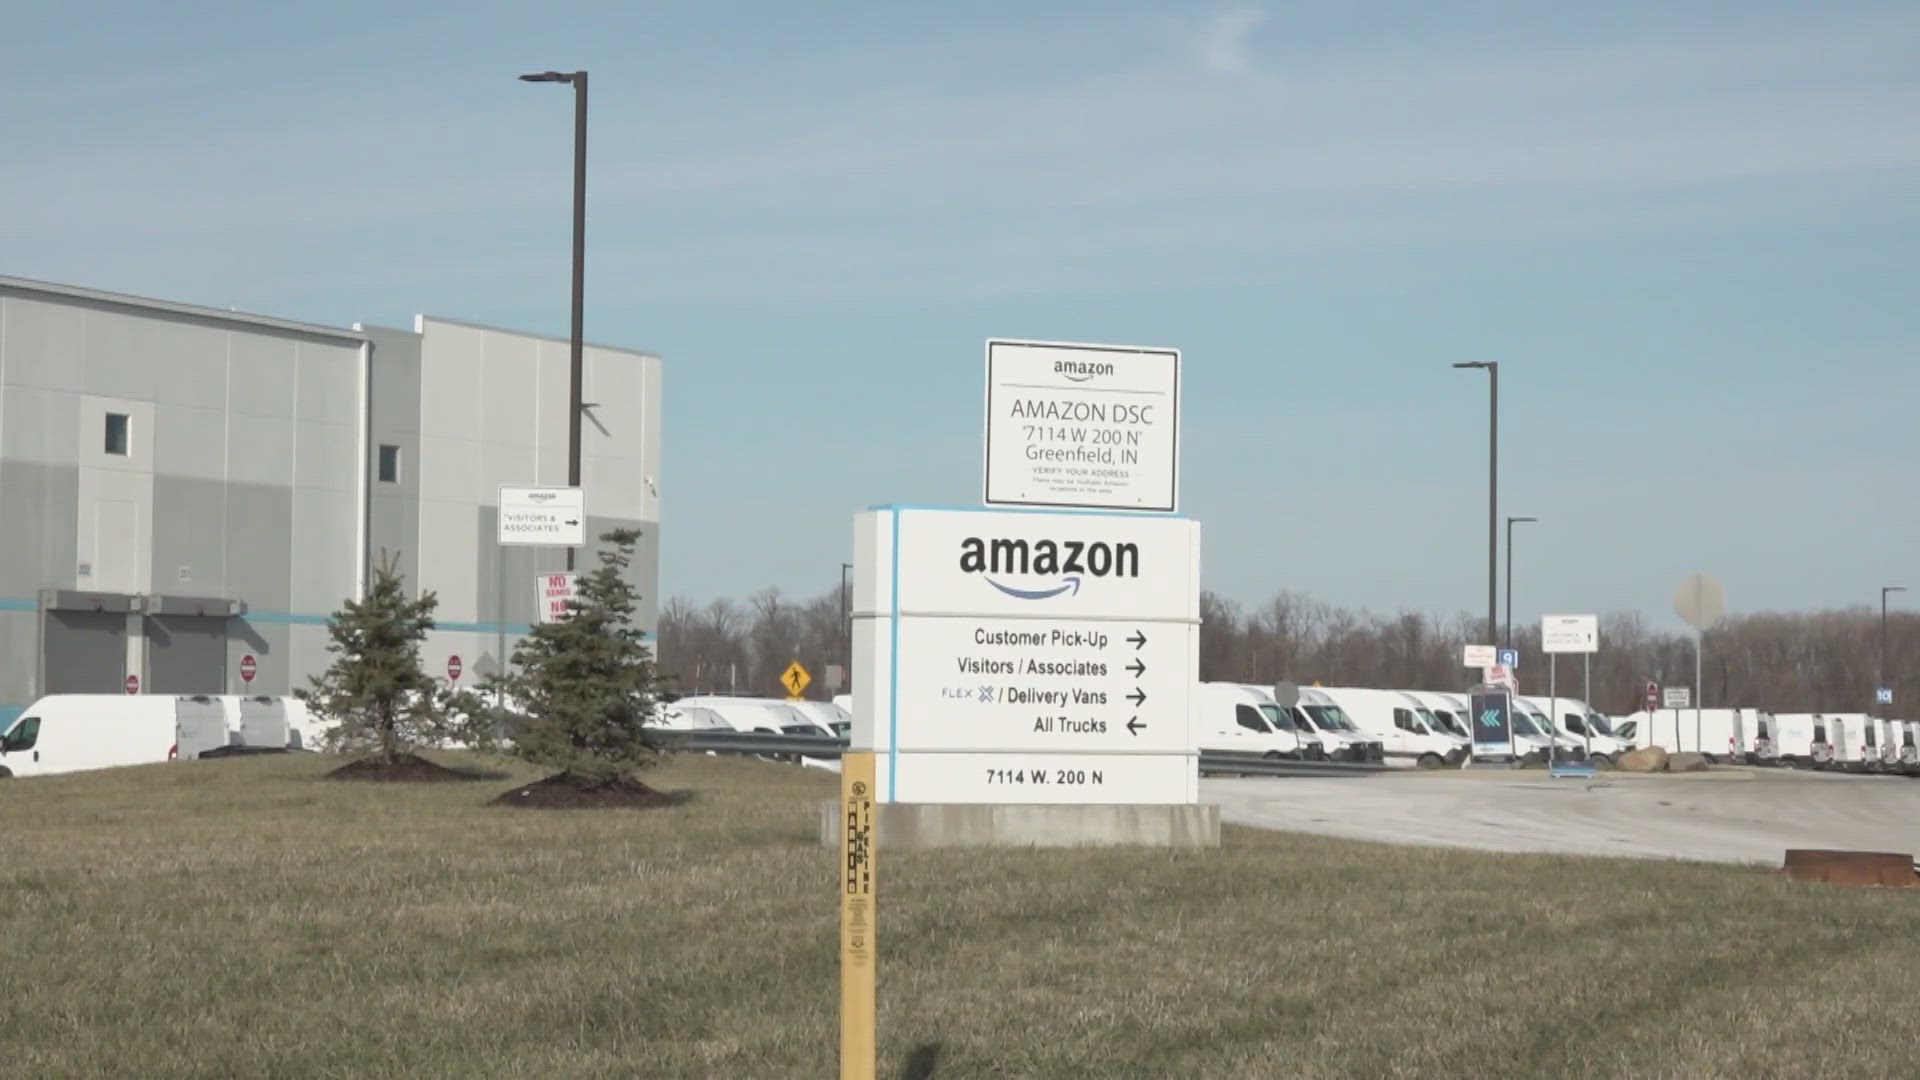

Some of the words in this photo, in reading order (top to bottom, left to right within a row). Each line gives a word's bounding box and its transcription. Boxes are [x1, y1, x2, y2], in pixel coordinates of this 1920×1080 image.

[1054, 360, 1114, 376] amazon
[1011, 399, 1105, 422] AMAZON
[1113, 403, 1153, 425] DSC
[1071, 428, 1087, 442] W
[1092, 429, 1122, 445] 200
[1026, 444, 1116, 465] Greenfield,
[1121, 449, 1138, 464] IN
[1032, 466, 1062, 474] VERIFY
[1066, 468, 1088, 476] YOUR
[1091, 469, 1129, 478] ADDRESS
[504, 524, 559, 532] ASSOCIATES
[959, 537, 1139, 578] amazon
[549, 575, 566, 588] NO
[975, 627, 1046, 646] Customer
[1051, 629, 1108, 650] Pick-Up
[957, 657, 1014, 674] Visitors
[1026, 658, 1107, 676] Associates
[942, 687, 973, 699] FLEX
[1008, 687, 1068, 708] Delivery
[1072, 688, 1107, 704] Vans
[1033, 716, 1053, 732] All
[1058, 717, 1107, 733] Trucks
[987, 769, 1025, 784] 7114
[1031, 770, 1051, 784] W.
[1057, 770, 1086, 785] 200
[1092, 771, 1104, 785] N
